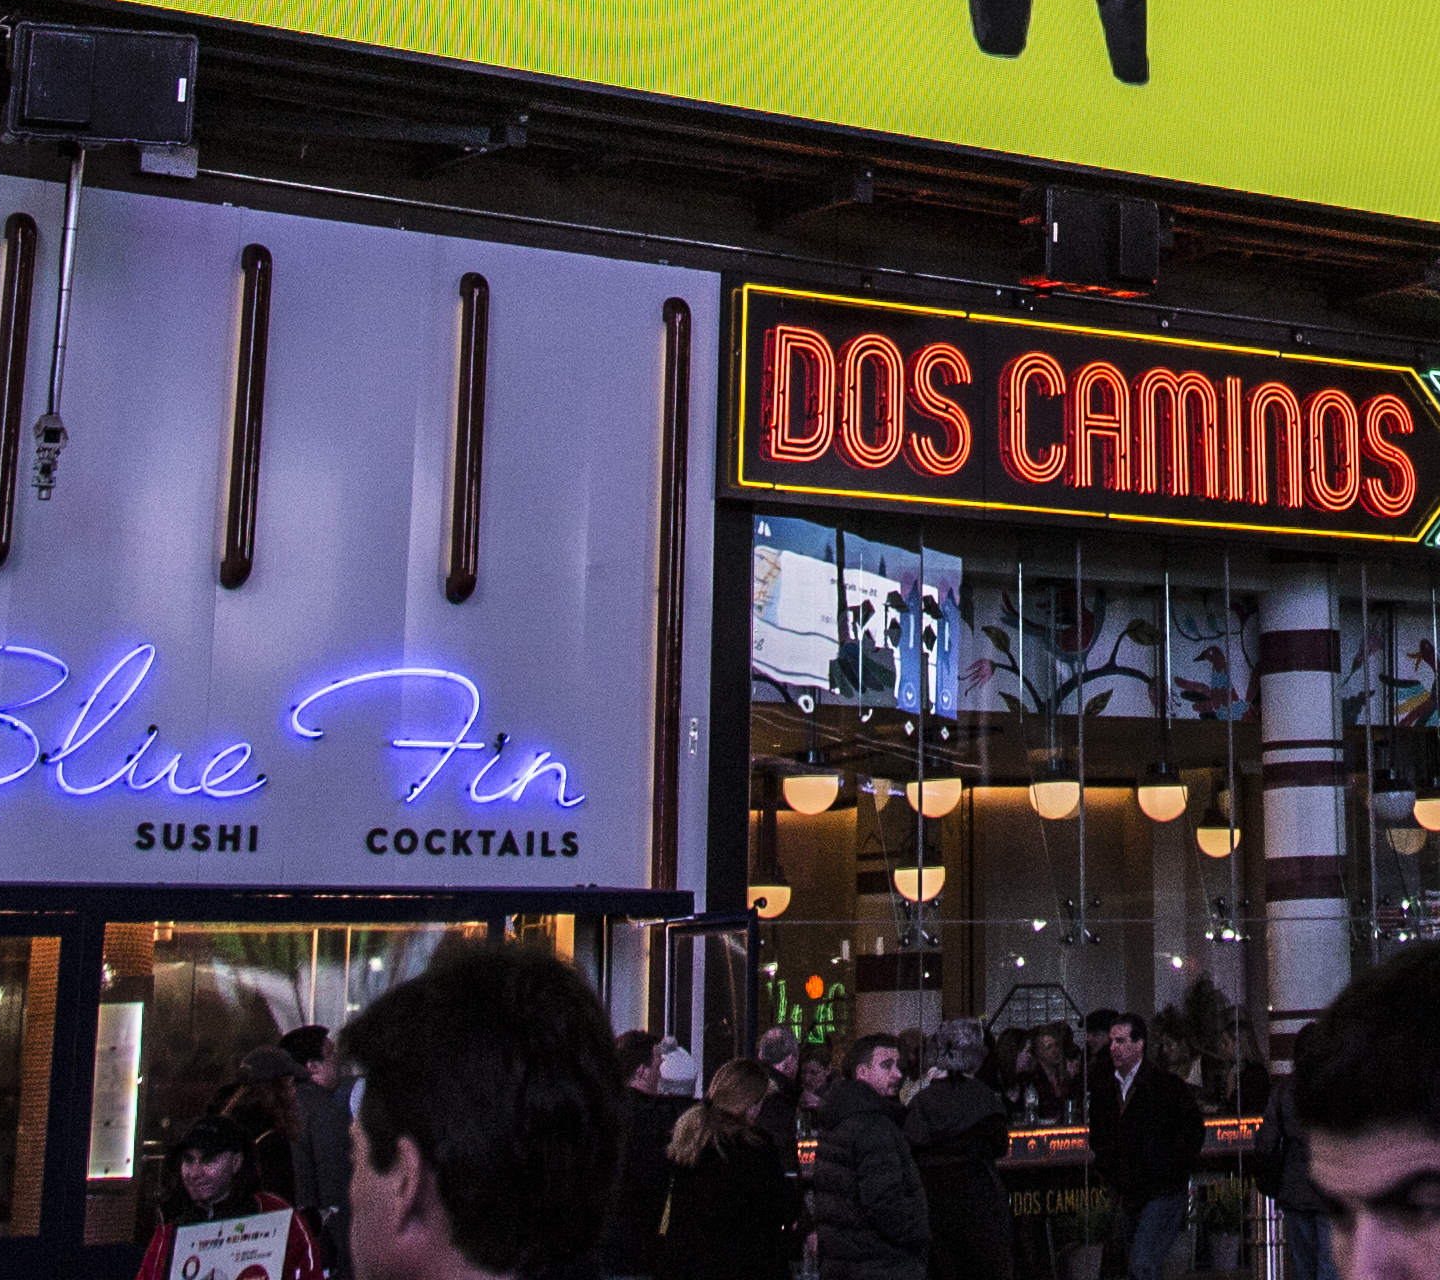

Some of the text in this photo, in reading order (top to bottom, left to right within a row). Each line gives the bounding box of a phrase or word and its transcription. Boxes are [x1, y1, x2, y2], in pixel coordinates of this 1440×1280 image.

[763, 323, 1418, 519] DOS CAMINOS
[291, 667, 586, 810] Fin
[134, 822, 261, 854] SUSHI
[366, 827, 581, 858] COCKTAILS
[1013, 1190, 1042, 1217] DOS
